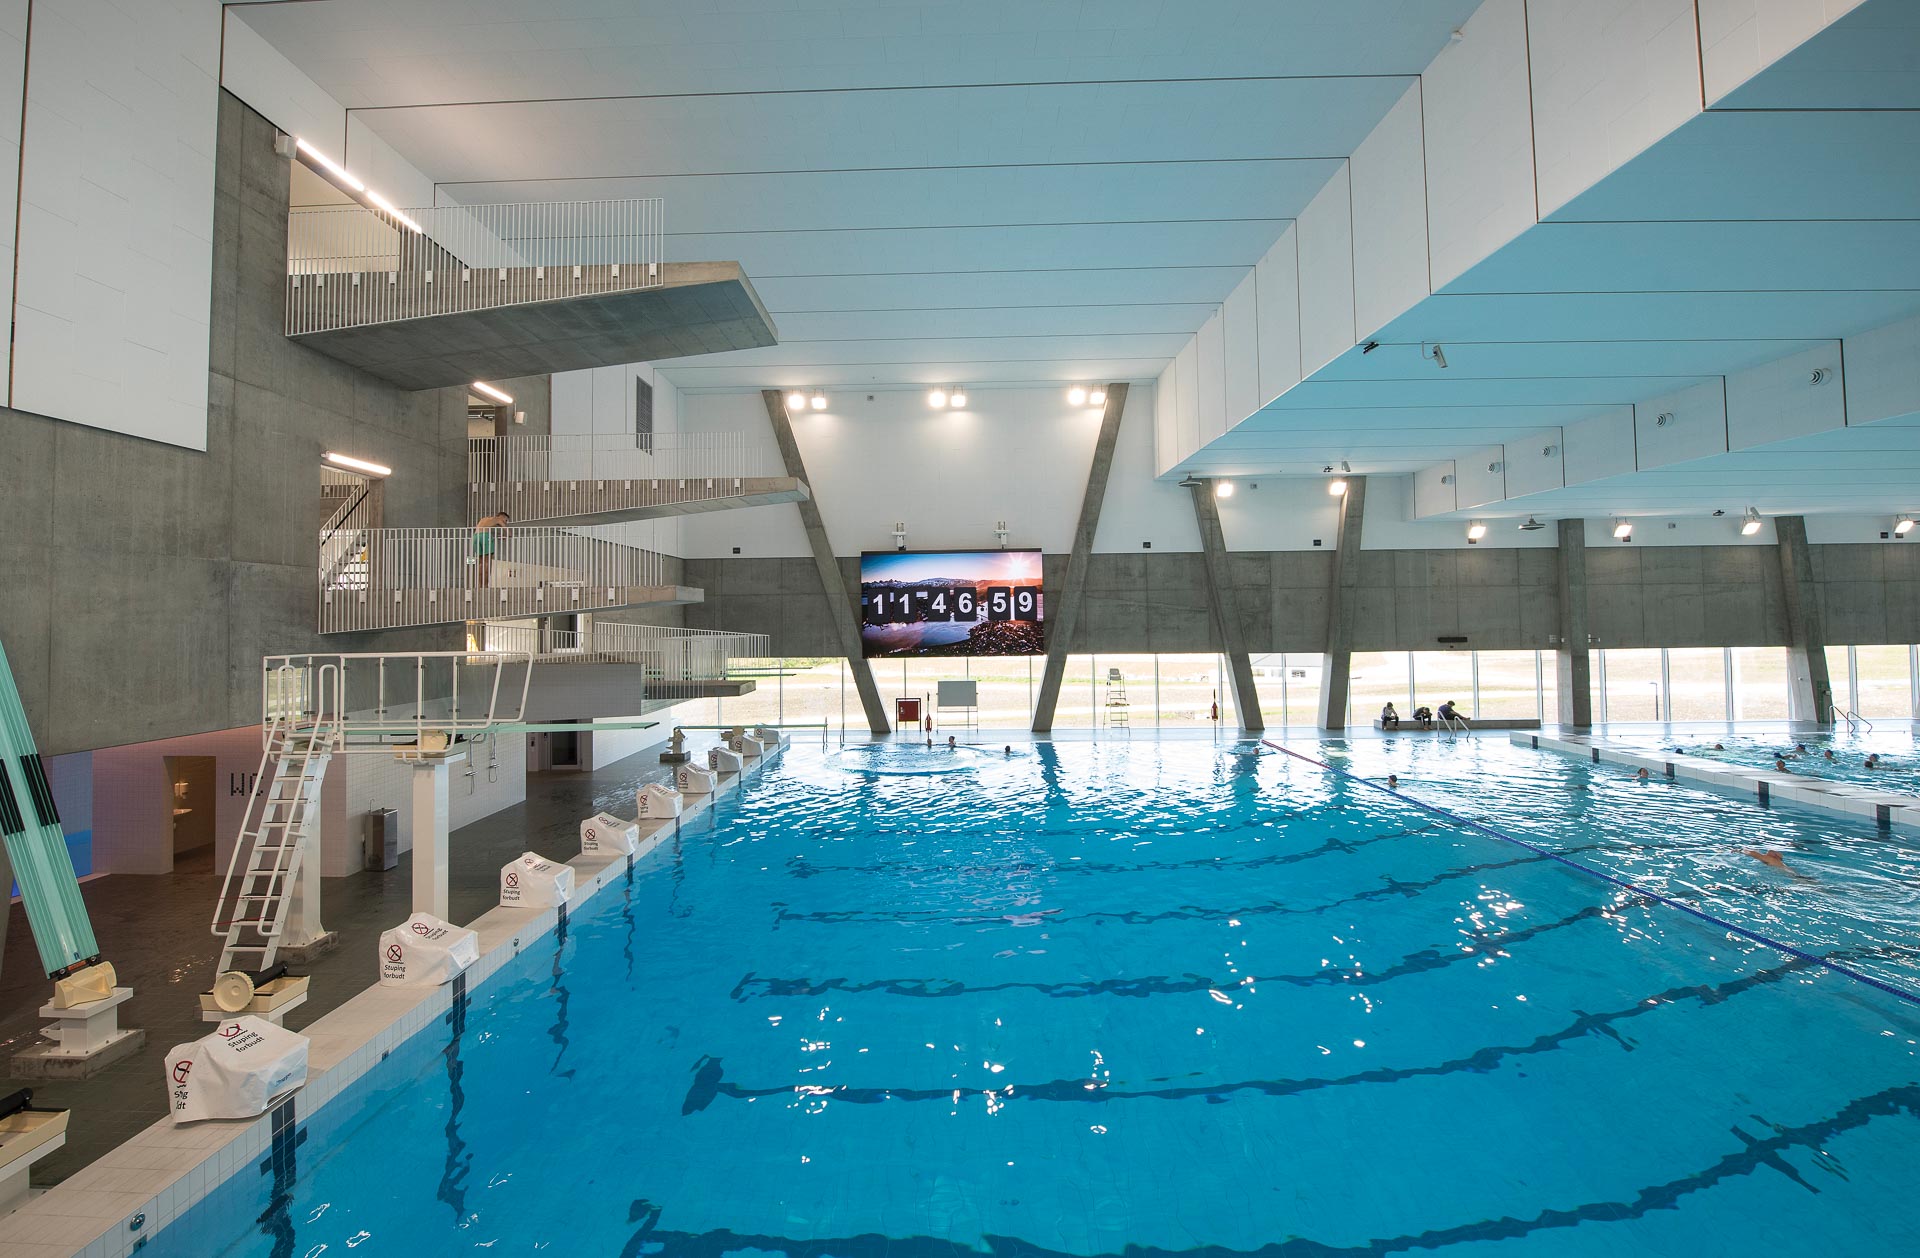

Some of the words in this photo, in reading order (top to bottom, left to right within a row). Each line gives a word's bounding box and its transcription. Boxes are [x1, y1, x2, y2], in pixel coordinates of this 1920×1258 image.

[231, 773, 263, 796] WC
[503, 888, 520, 896] Stuping
[384, 964, 406, 973] Stuping
[383, 972, 405, 980] forbudt
[228, 1031, 259, 1048] Stuping
[235, 1036, 265, 1053] forbudt
